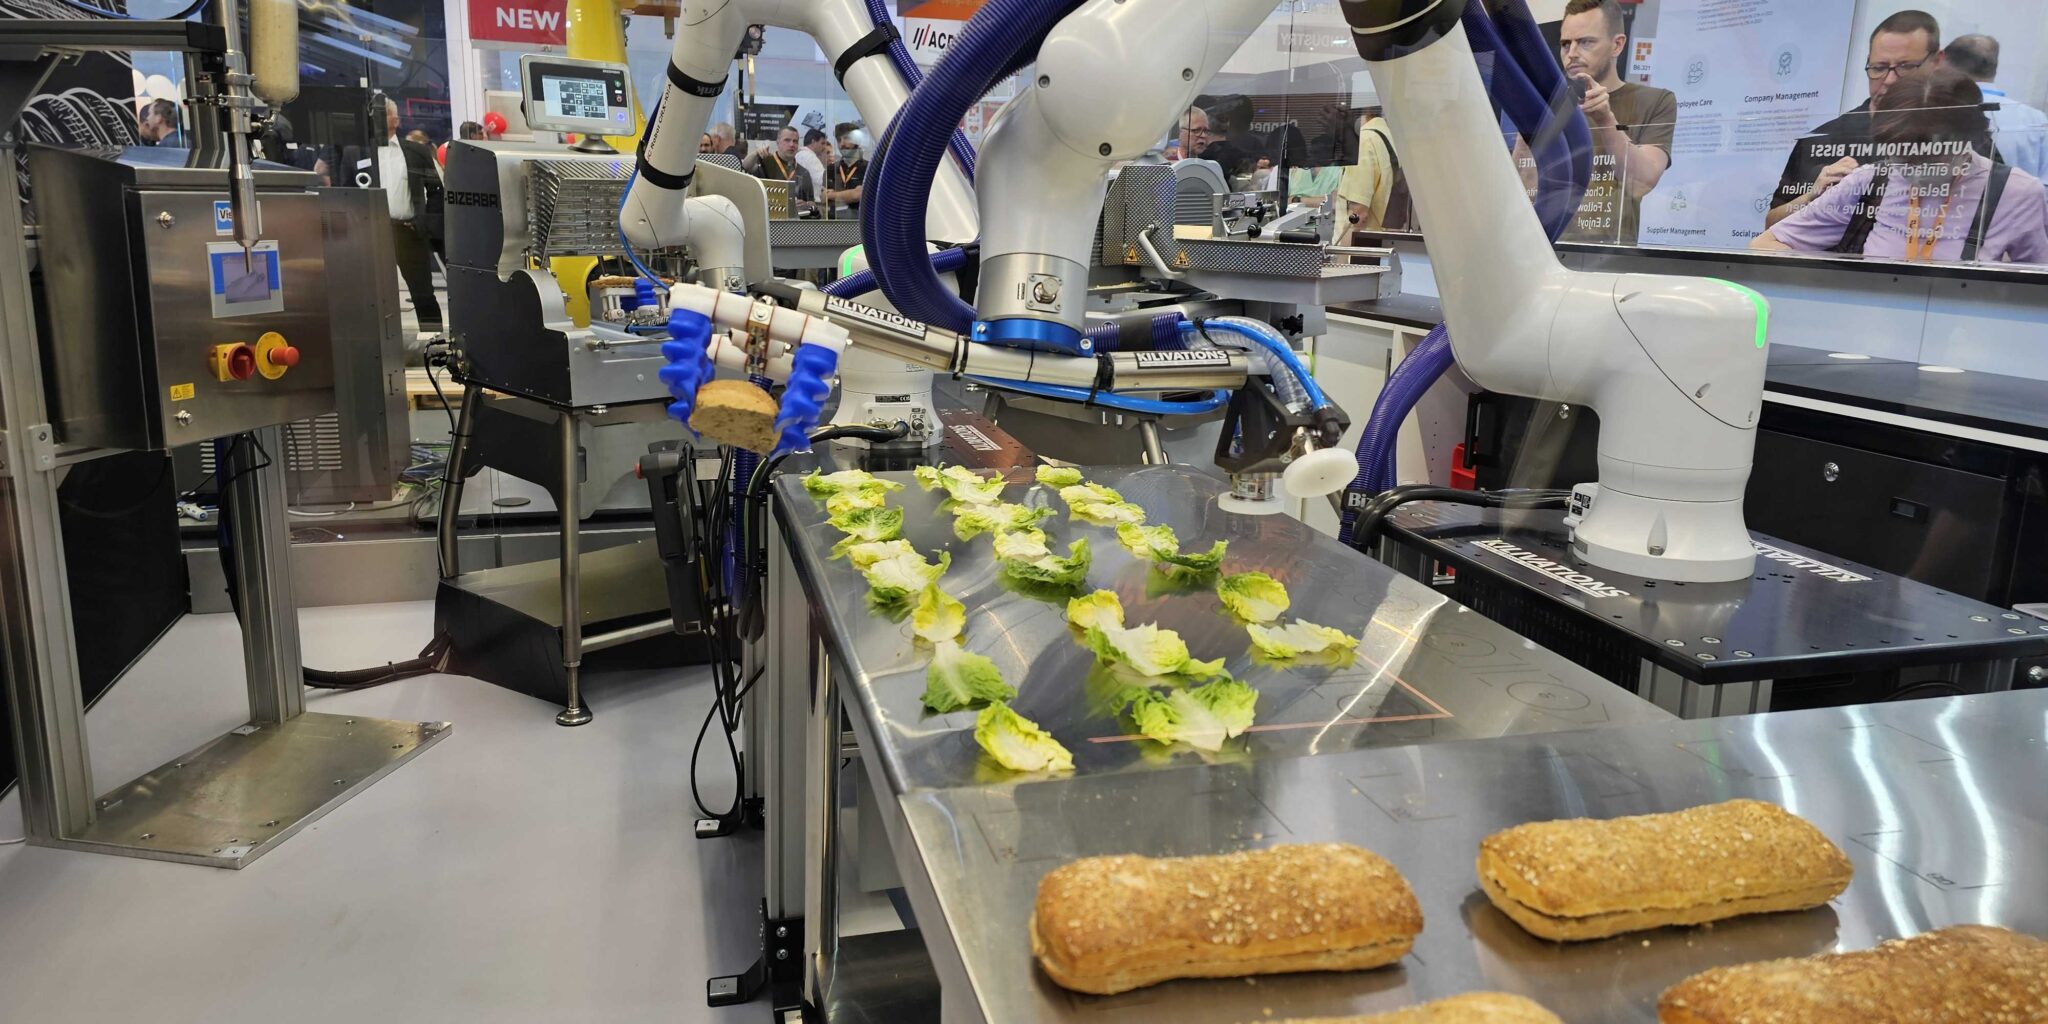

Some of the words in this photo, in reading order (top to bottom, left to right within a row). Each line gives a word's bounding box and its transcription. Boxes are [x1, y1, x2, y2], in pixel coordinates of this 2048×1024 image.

[496, 7, 560, 31] NEW
[1700, 99, 1713, 107] Care
[1744, 95, 1774, 104] Company
[1775, 90, 1819, 101] Management
[447, 191, 498, 208] BIZERBA
[1646, 226, 1670, 236] Supplier
[1670, 227, 1706, 237] Management
[1731, 229, 1750, 238] Social
[828, 295, 926, 331] KILIVATIONS
[1136, 350, 1228, 361] KILIVATIONS
[1480, 539, 1631, 597] KILIVATIONS
